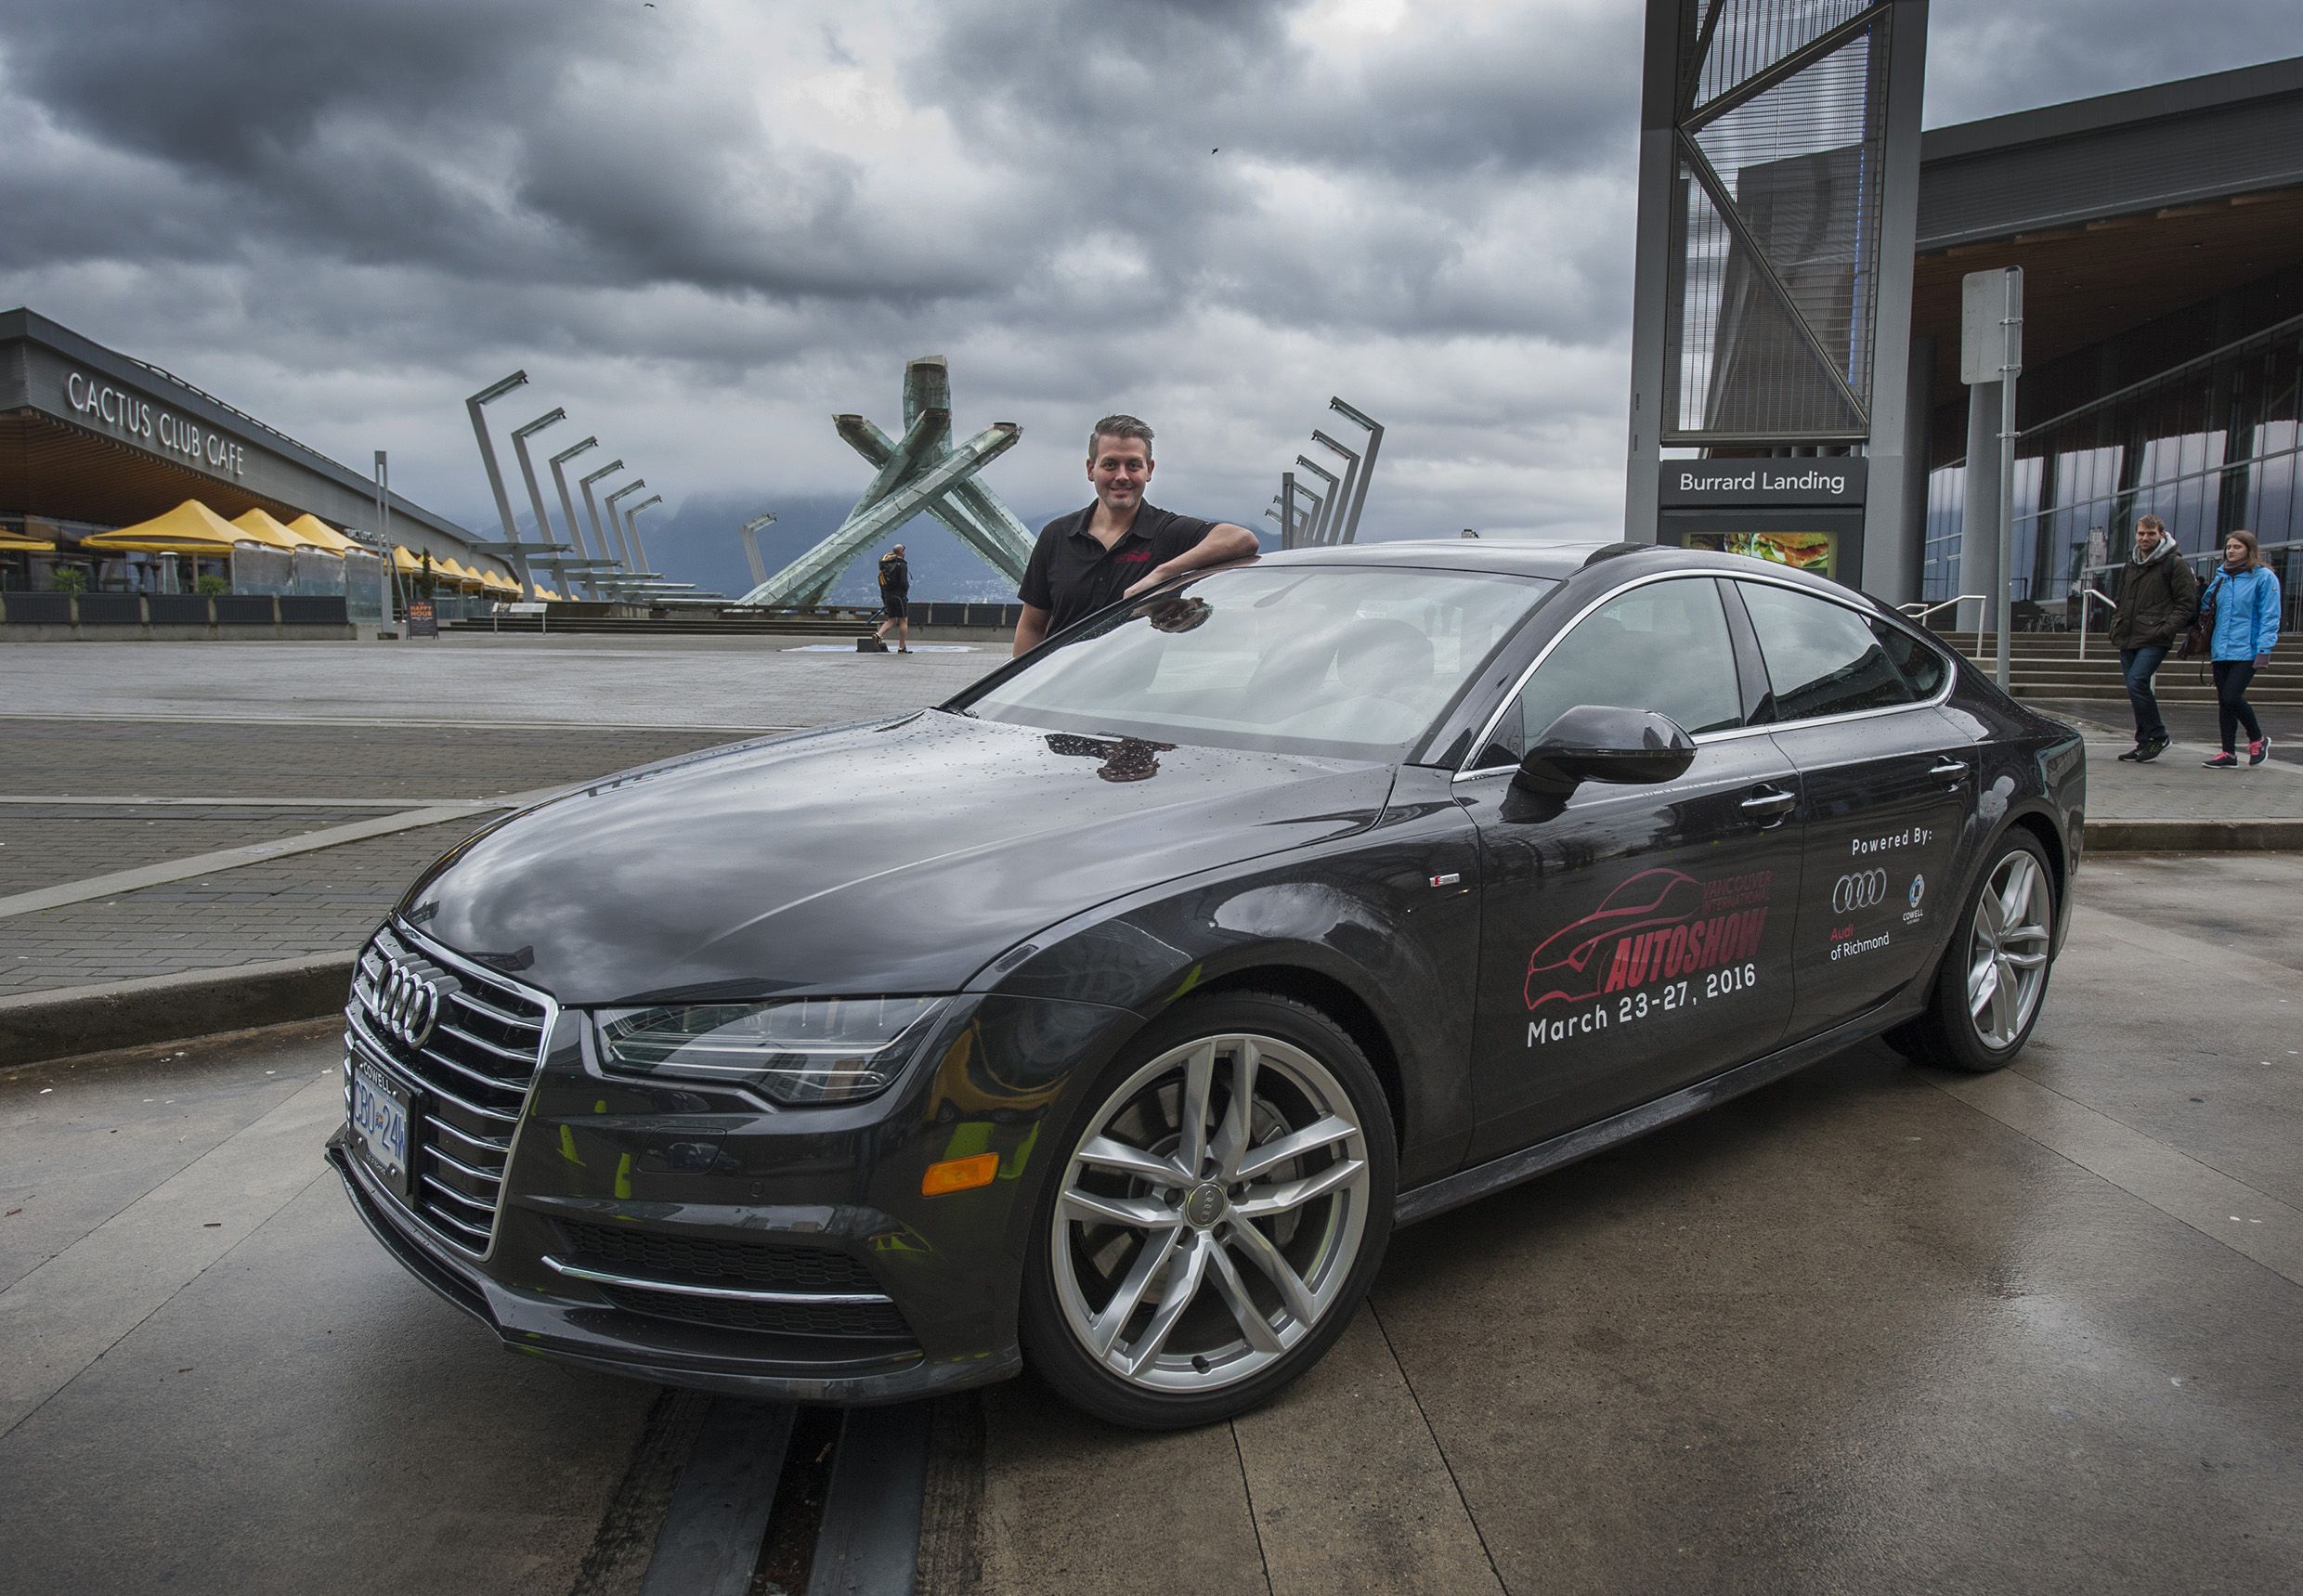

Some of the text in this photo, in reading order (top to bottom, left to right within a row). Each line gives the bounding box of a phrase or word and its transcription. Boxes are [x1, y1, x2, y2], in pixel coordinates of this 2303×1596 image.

[67, 372, 243, 475] CACTUS CLUB CAFE
[1680, 470, 1845, 495] Burrard Landing
[1852, 826, 1932, 855] Powered By:
[1902, 909, 1923, 921] COWELL
[1829, 923, 1854, 941] Audi
[1830, 931, 1890, 961] of Richmond
[1604, 906, 1769, 993] AUTOSHOW
[1527, 963, 1756, 1047] March 23-27, 2016
[363, 1061, 392, 1095] COWELL
